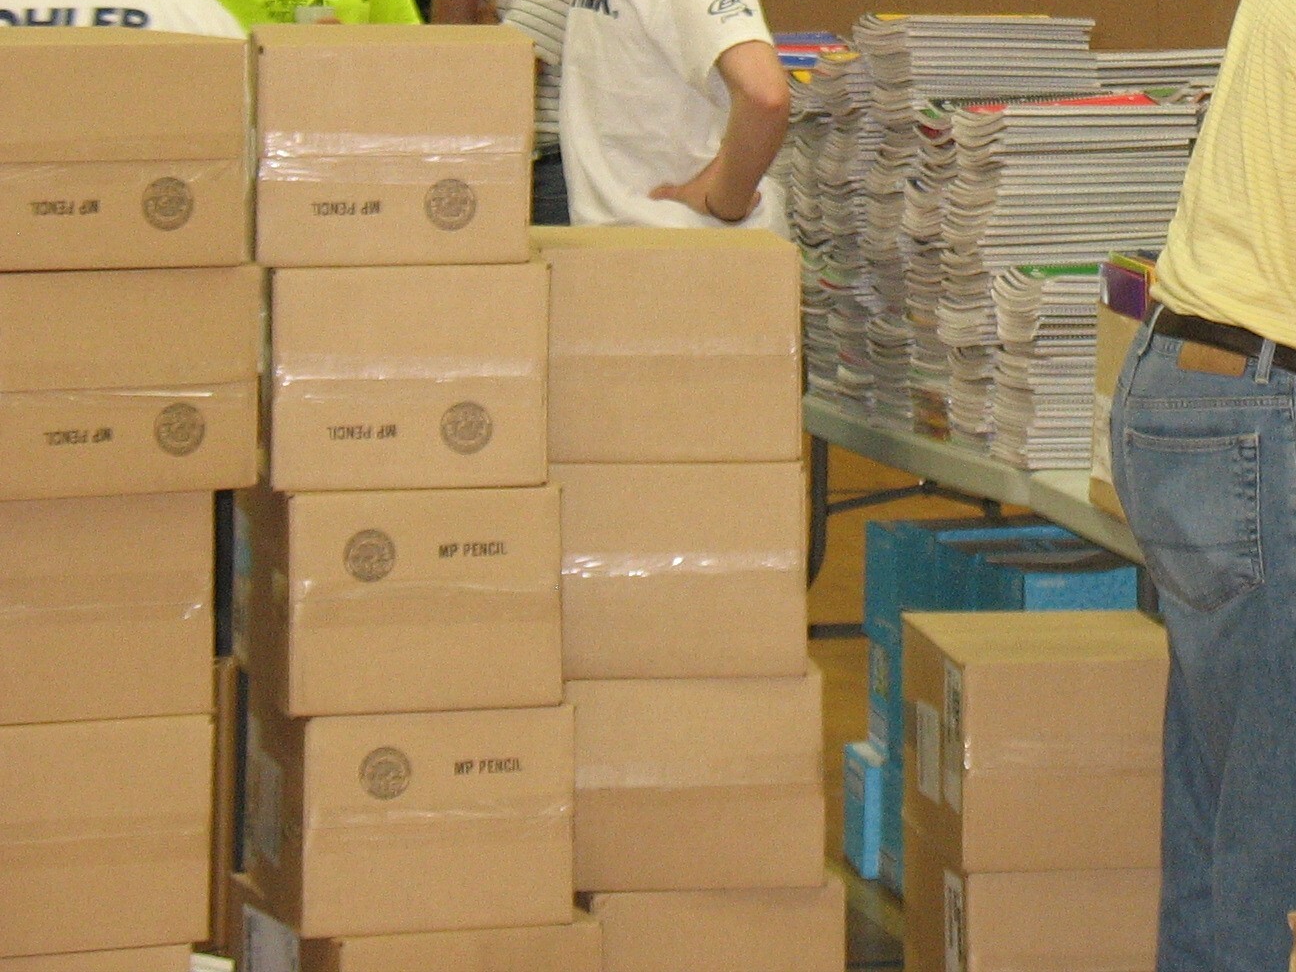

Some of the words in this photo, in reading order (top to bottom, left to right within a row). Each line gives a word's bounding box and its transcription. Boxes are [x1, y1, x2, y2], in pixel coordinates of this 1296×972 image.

[439, 544, 457, 558] MP
[463, 542, 506, 556] PENCIL
[454, 760, 473, 775] MP
[478, 758, 522, 773] PENCIL
